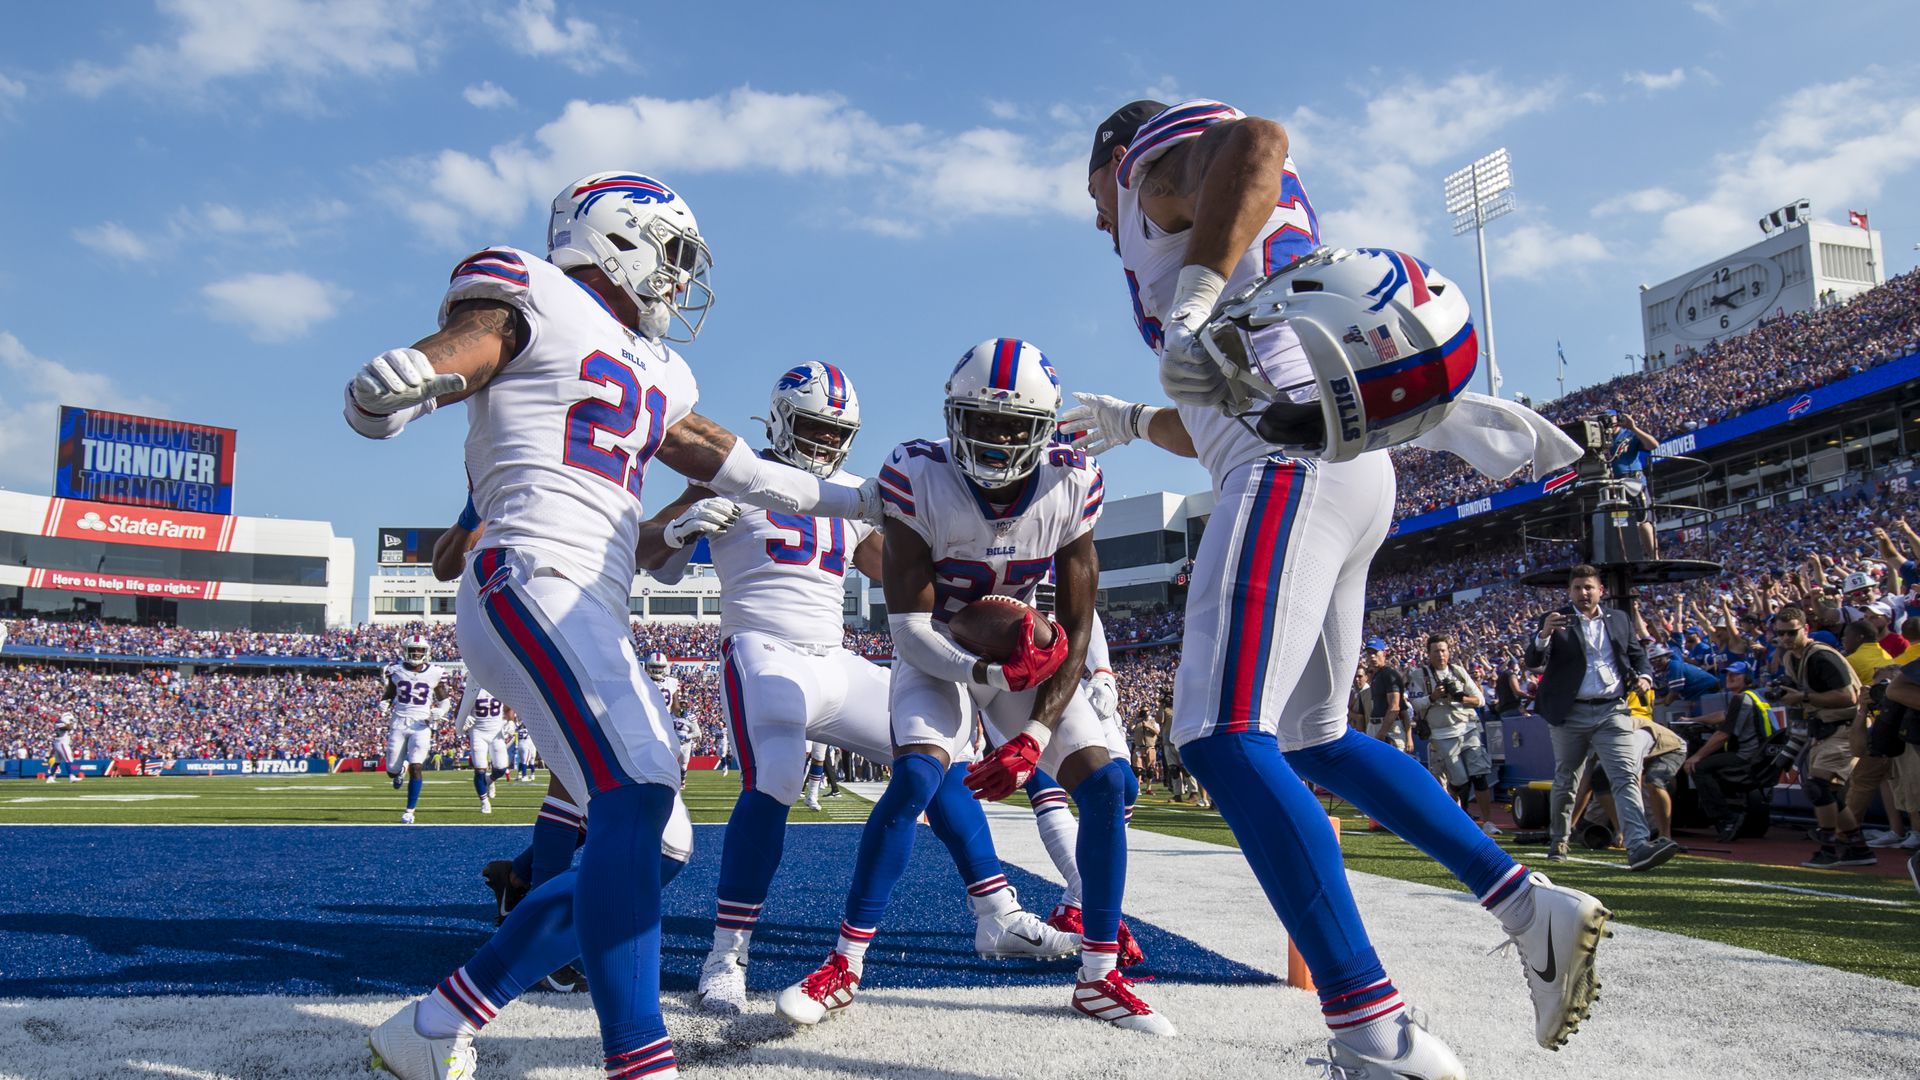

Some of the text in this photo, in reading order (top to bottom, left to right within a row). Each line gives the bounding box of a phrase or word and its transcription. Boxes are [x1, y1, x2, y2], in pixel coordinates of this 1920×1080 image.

[1713, 268, 1730, 284] 12
[1752, 281, 1760, 297] 3
[1688, 307, 1696, 321] 9
[1720, 315, 1729, 329] 6
[621, 348, 646, 371] BILLS
[1329, 376, 1361, 442] BILLS
[82, 409, 218, 454] TURNOVER
[563, 349, 667, 501] 21
[81, 438, 216, 484] TURNOVER
[79, 470, 215, 513] TURNOVER
[1457, 497, 1492, 518] TURNOVER
[986, 546, 1016, 556] BILLS
[52, 573, 81, 586] Here
[84, 577, 96, 587] to
[99, 577, 123, 591] help
[126, 579, 145, 592] life
[147, 583, 162, 593] go
[397, 681, 429, 705] 33
[475, 698, 501, 717] 58
